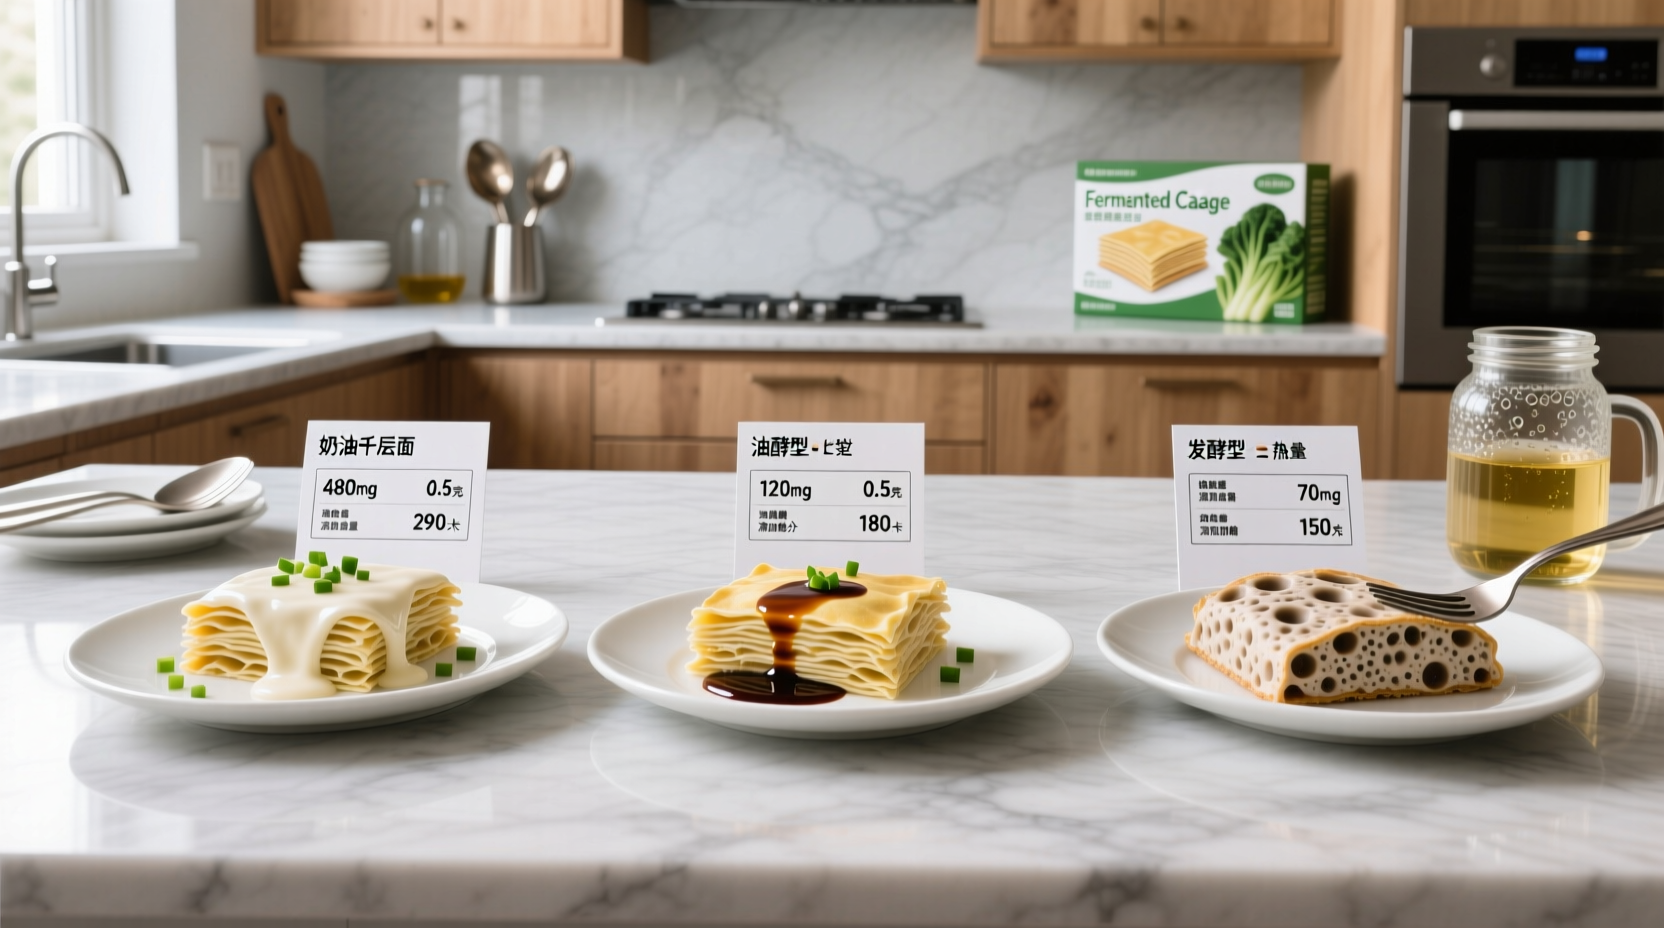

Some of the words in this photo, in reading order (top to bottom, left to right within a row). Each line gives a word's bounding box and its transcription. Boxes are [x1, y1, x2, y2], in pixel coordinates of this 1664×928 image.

[1085, 190, 1171, 209] Fermented
[1175, 190, 1230, 215] Caage
[318, 434, 416, 457] 奶油千层面
[322, 478, 378, 500] 480mg
[759, 479, 812, 501] 120mg
[1297, 483, 1341, 506] 70mg
